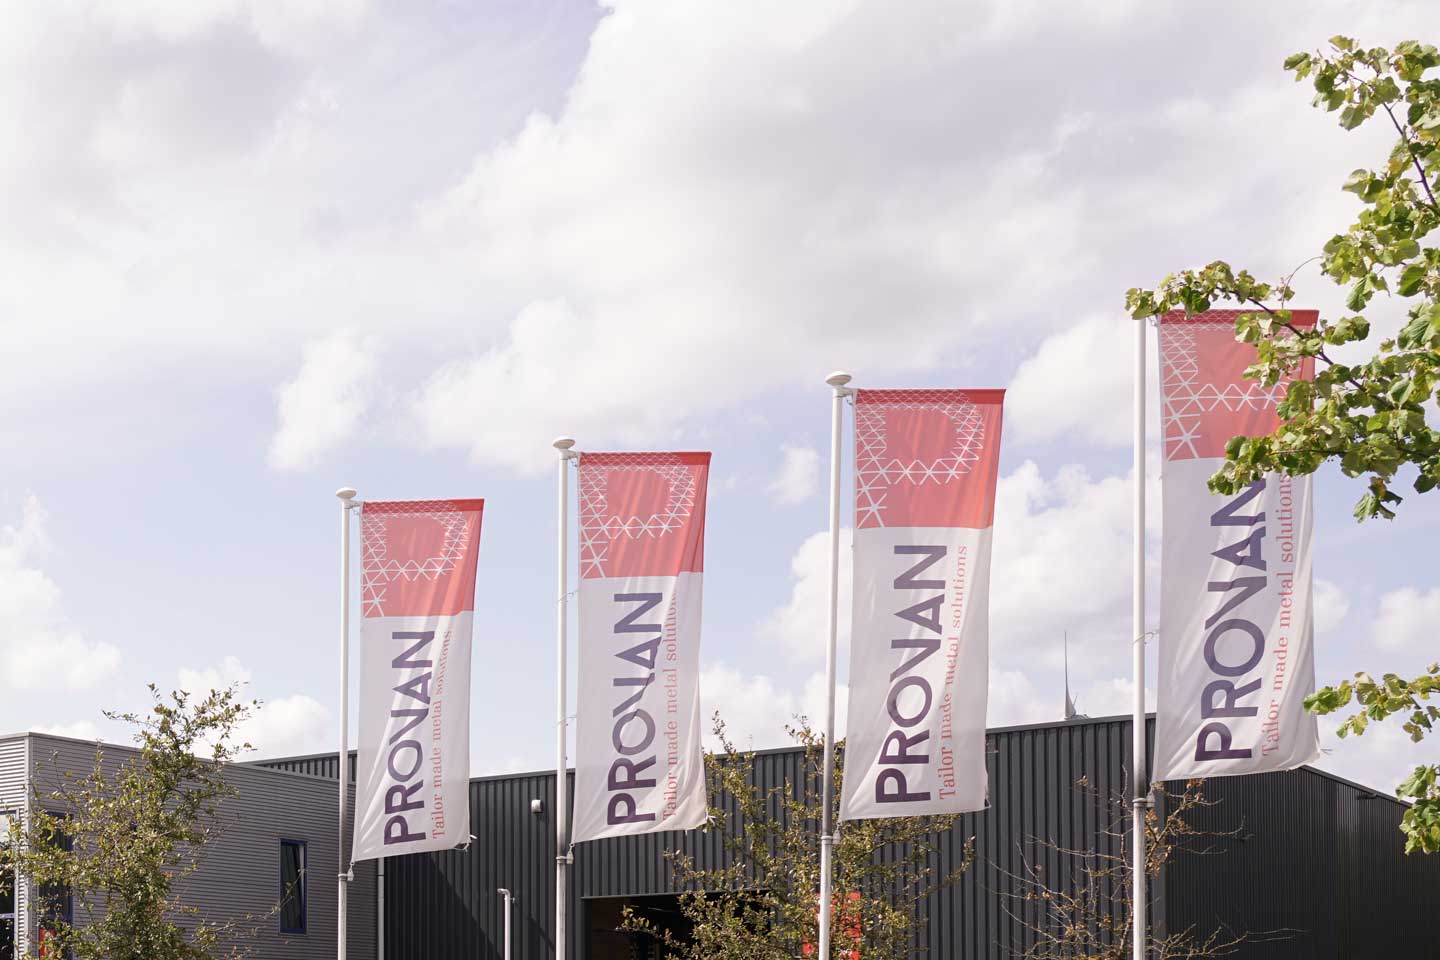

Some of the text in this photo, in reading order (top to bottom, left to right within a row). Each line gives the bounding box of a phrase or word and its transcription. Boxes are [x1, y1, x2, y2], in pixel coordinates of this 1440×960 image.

[875, 544, 947, 803] PROVAN
[938, 545, 967, 800] Tailor made metal solutions
[1195, 478, 1267, 761] PROVAN
[1262, 474, 1294, 757] Tailor made metal solutions
[384, 631, 435, 845] PROVAN
[432, 700, 442, 741] metal
[607, 592, 663, 825] PROVAN
[663, 669, 678, 713] metal
[663, 720, 678, 767] made
[429, 750, 442, 789] made
[433, 794, 445, 841] Tailor
[663, 773, 678, 821] Tailor
